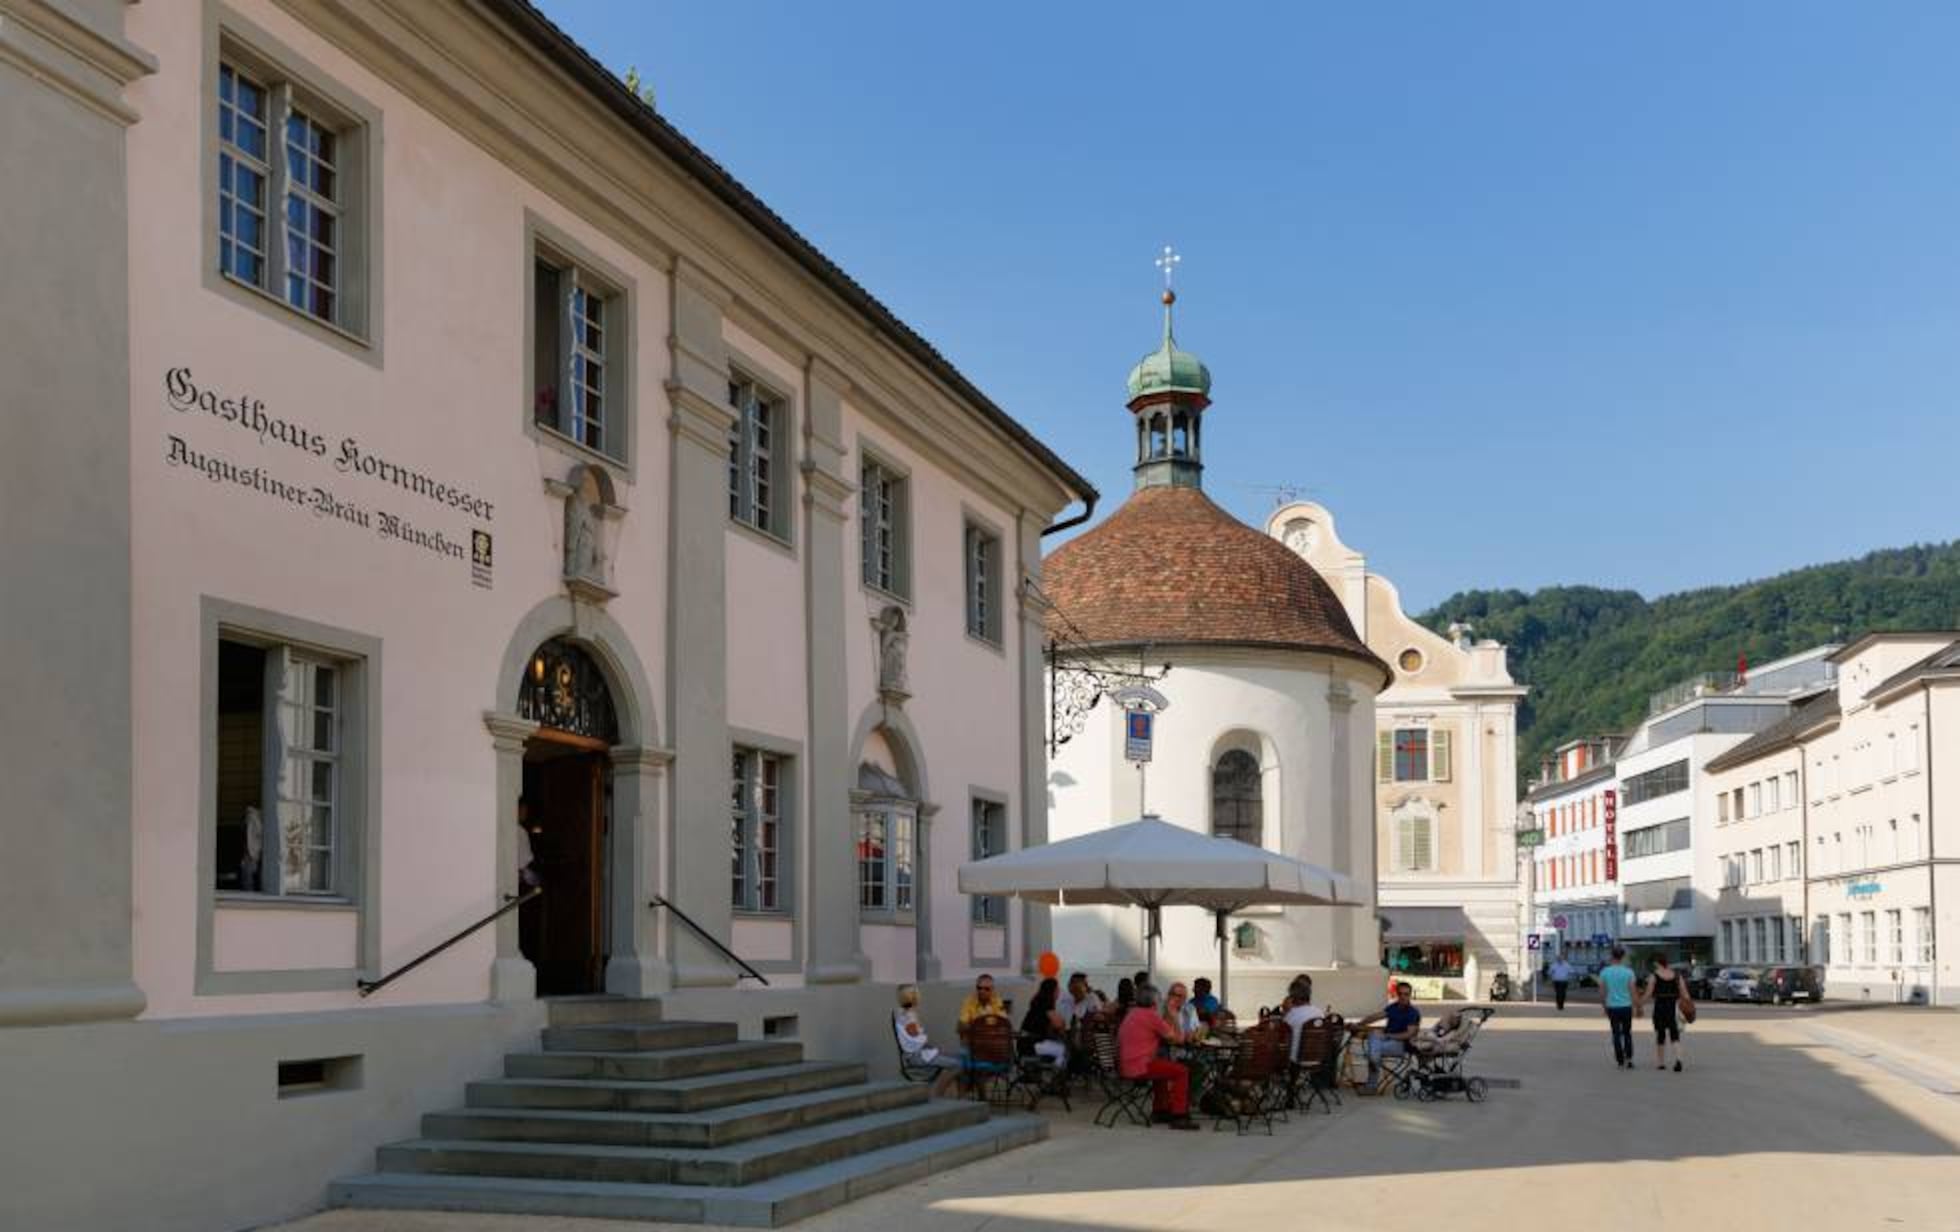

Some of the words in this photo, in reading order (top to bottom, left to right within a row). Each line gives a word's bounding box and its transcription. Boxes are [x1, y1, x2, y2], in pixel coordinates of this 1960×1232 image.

[166, 367, 327, 457] Gasthaus
[335, 437, 495, 522] Kornmesser
[166, 434, 370, 528] Augustiner-Bräu
[377, 511, 465, 560] München
[1605, 796, 1615, 859] HOTEL
